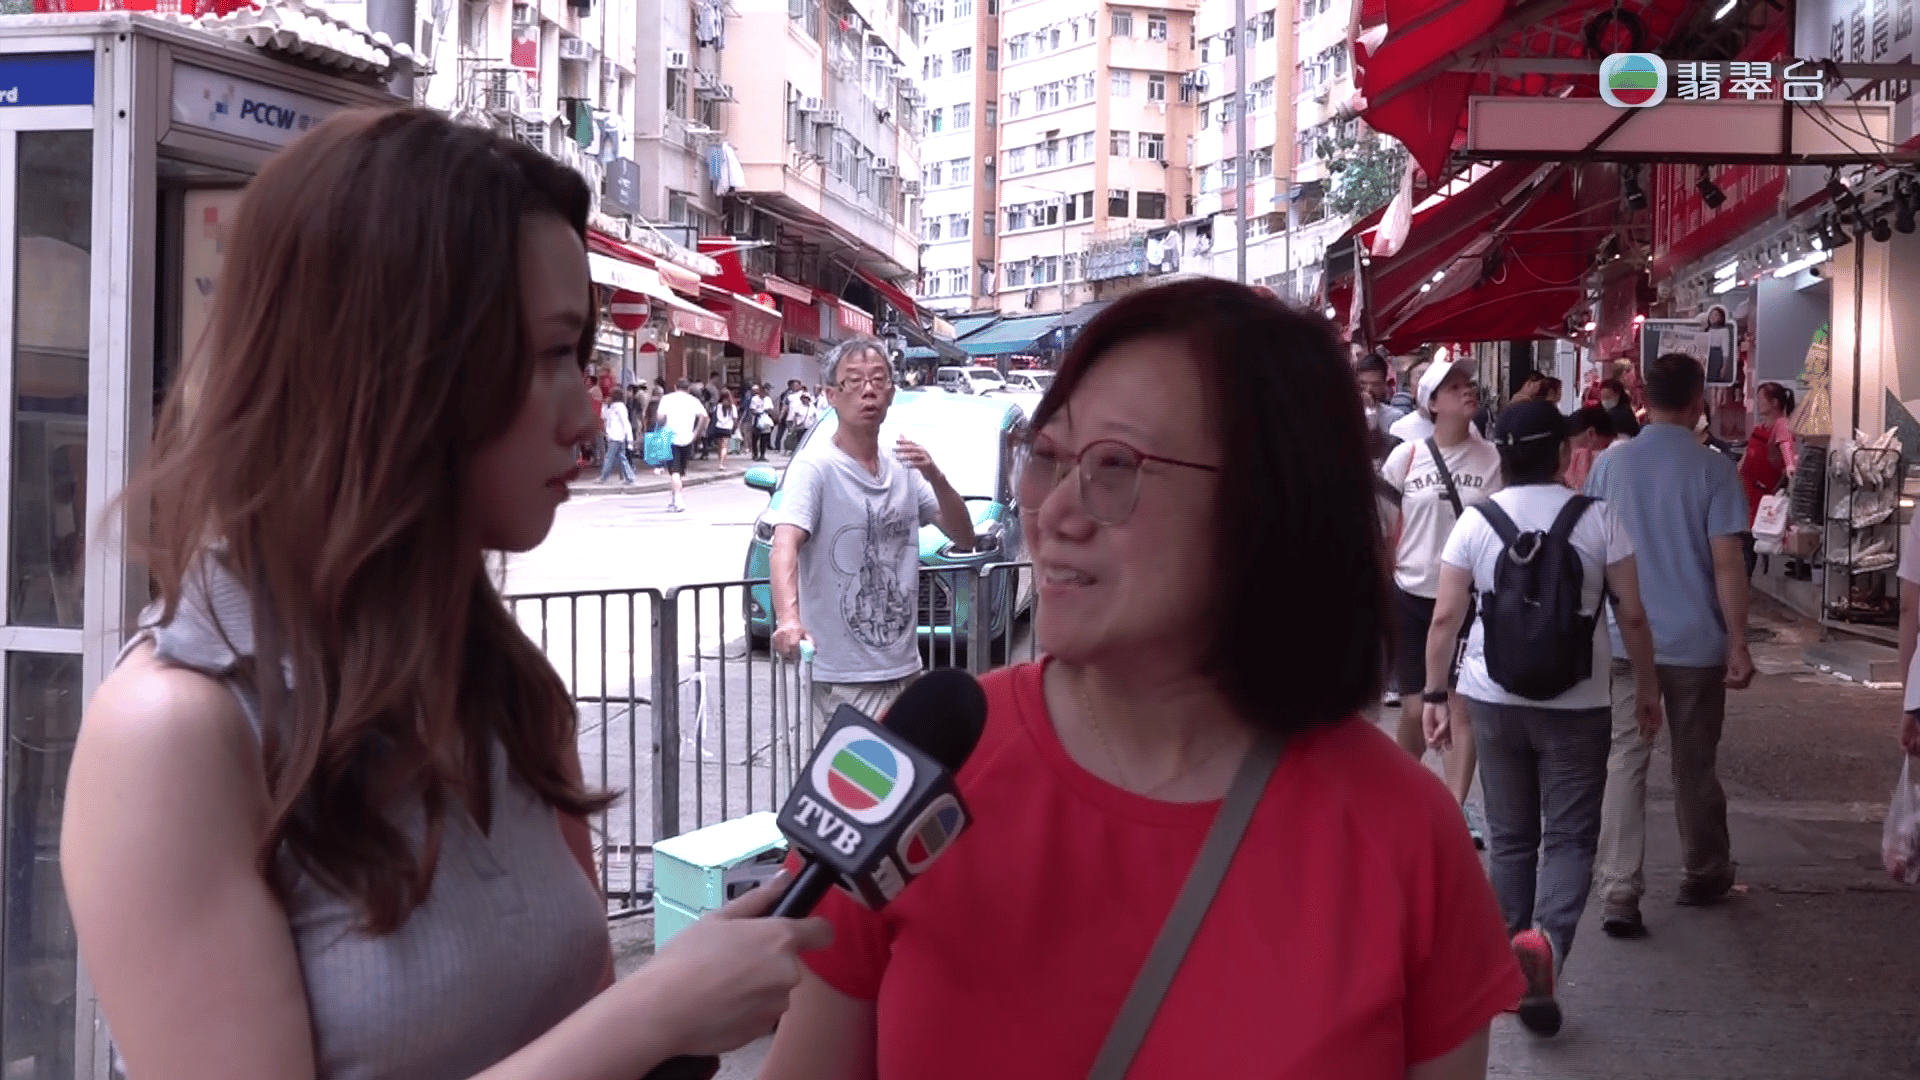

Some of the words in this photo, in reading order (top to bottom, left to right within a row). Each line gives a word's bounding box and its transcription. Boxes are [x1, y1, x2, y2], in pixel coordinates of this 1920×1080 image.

[240, 98, 296, 130] PCCW
[1412, 472, 1484, 490] BARARD
[793, 794, 862, 856] TVB
